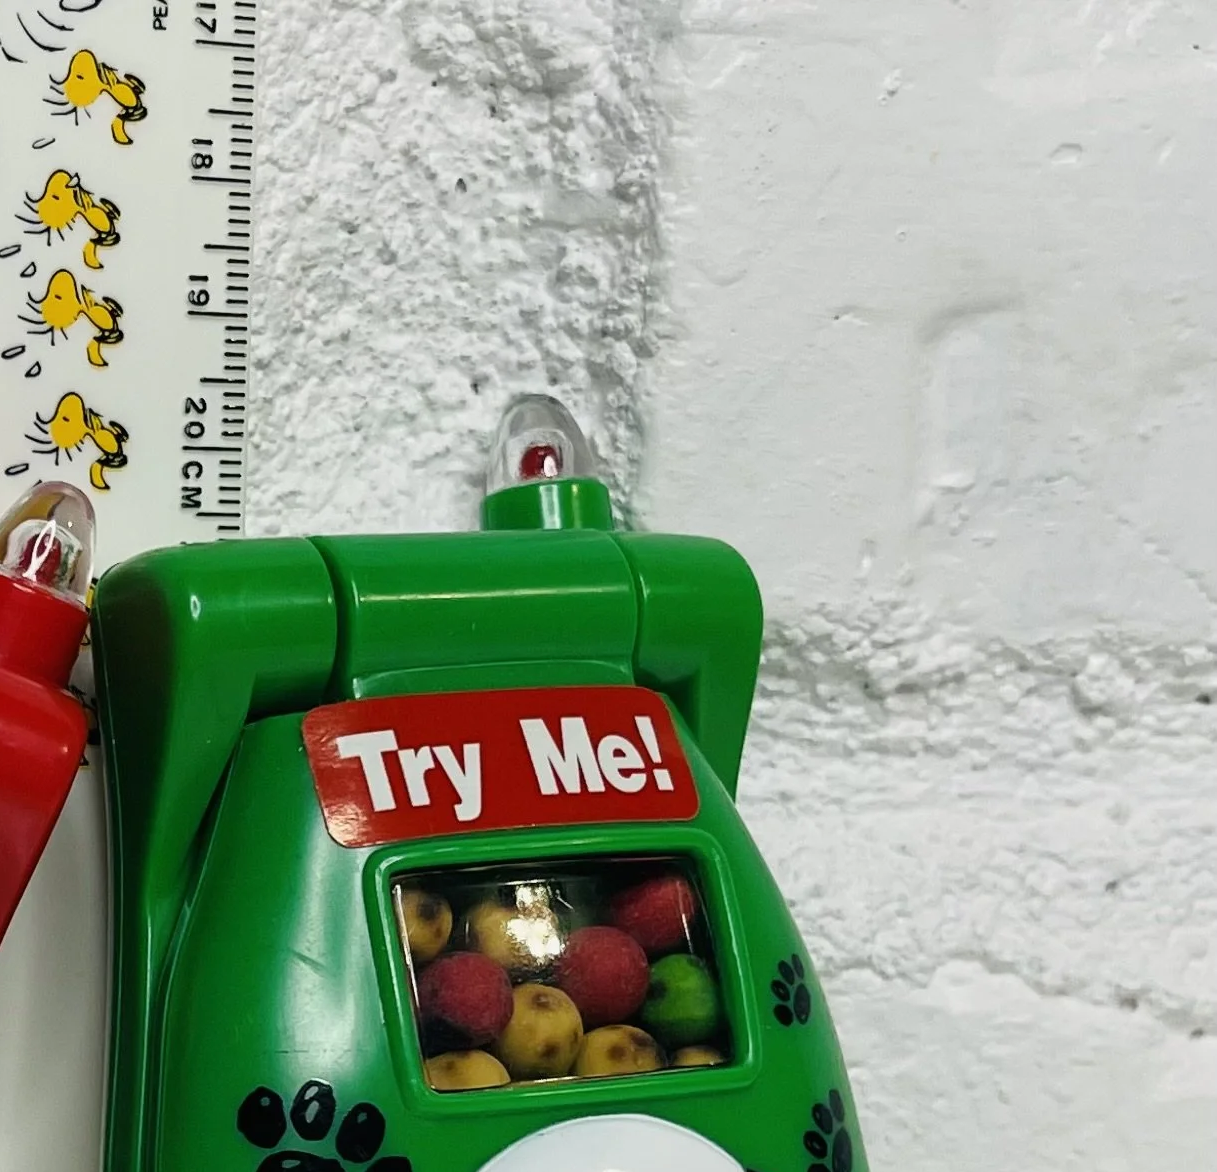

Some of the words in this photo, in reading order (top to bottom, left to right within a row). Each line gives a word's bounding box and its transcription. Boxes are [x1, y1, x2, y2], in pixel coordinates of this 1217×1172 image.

[152, 0, 168, 31] PE
[194, 2, 217, 34] 17
[190, 138, 214, 170] 18
[187, 274, 210, 307] 19
[183, 397, 208, 440] 20
[181, 460, 204, 510] CM
[336, 729, 482, 821] Try
[519, 715, 675, 796] Me!
